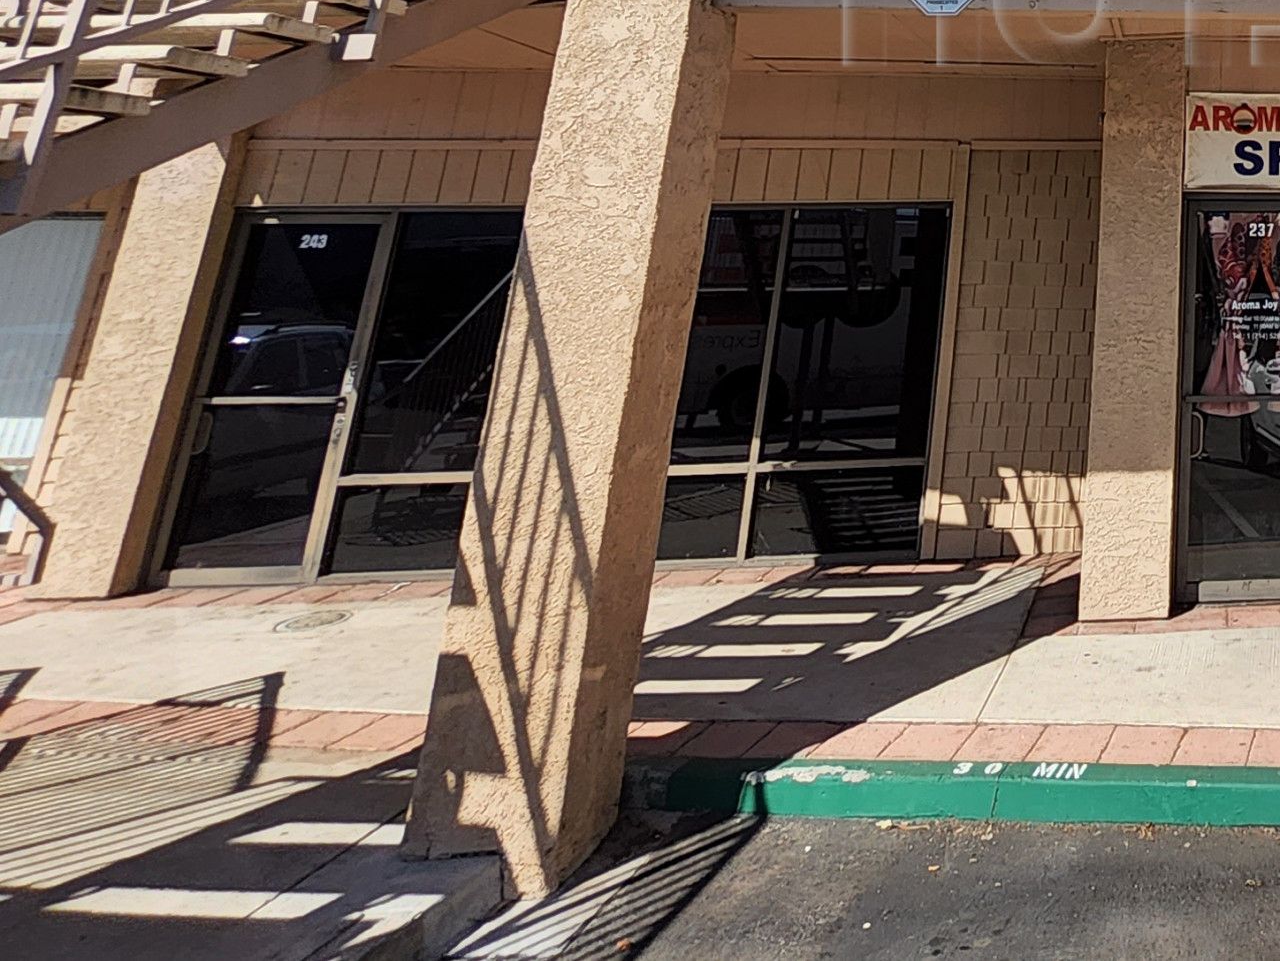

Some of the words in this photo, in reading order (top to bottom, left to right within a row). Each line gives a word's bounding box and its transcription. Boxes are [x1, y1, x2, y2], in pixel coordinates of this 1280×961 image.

[1249, 223, 1274, 237] 237
[299, 234, 328, 249] 243
[1231, 300, 1260, 310] Aroma
[1262, 299, 1278, 311] Joy
[1032, 762, 1088, 779] MIN
